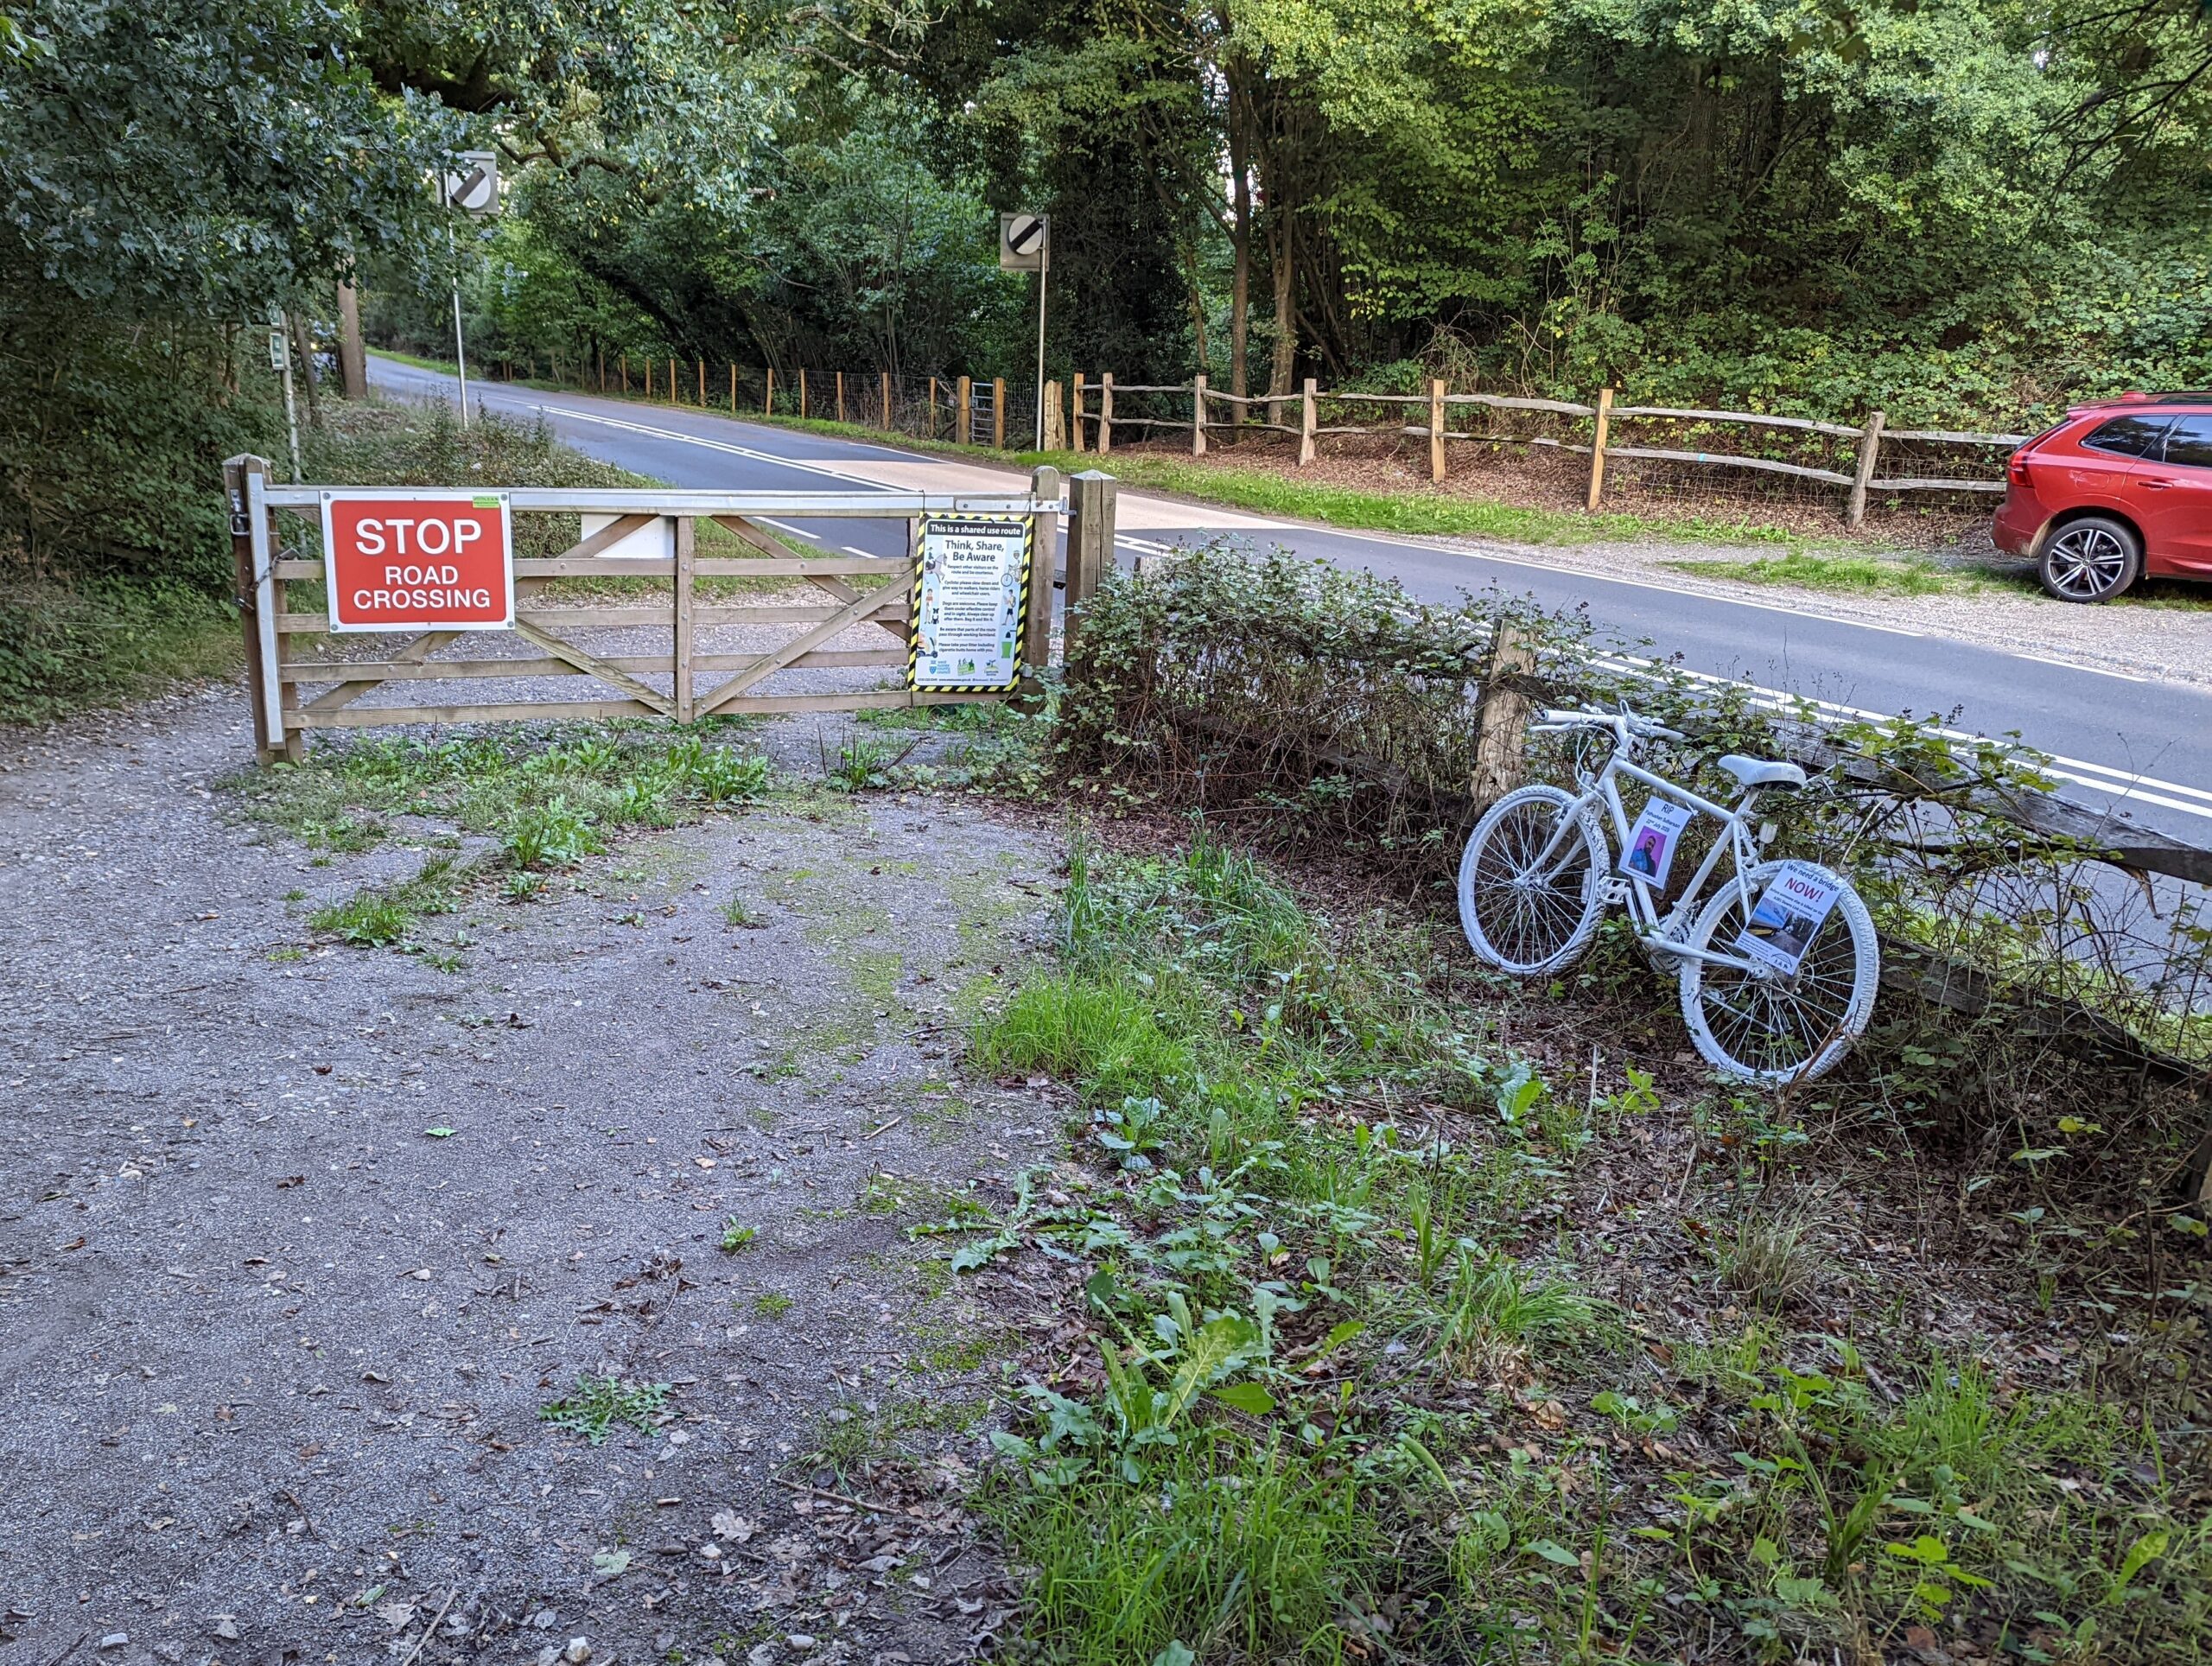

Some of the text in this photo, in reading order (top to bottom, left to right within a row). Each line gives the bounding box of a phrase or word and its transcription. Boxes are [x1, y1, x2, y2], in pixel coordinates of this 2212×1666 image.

[355, 518, 481, 555] STOP
[948, 525, 954, 533] is
[961, 525, 986, 534] shared
[945, 540, 1004, 551] Think, Share,
[953, 552, 995, 562] Be Aware
[385, 566, 459, 586] ROAD
[353, 588, 490, 609] CROSSING
[1662, 804, 1675, 814] RIP
[1787, 864, 1797, 873] We
[1798, 870, 1815, 880] need
[1818, 877, 1839, 892] bridge
[1784, 877, 1824, 903] NOW!
